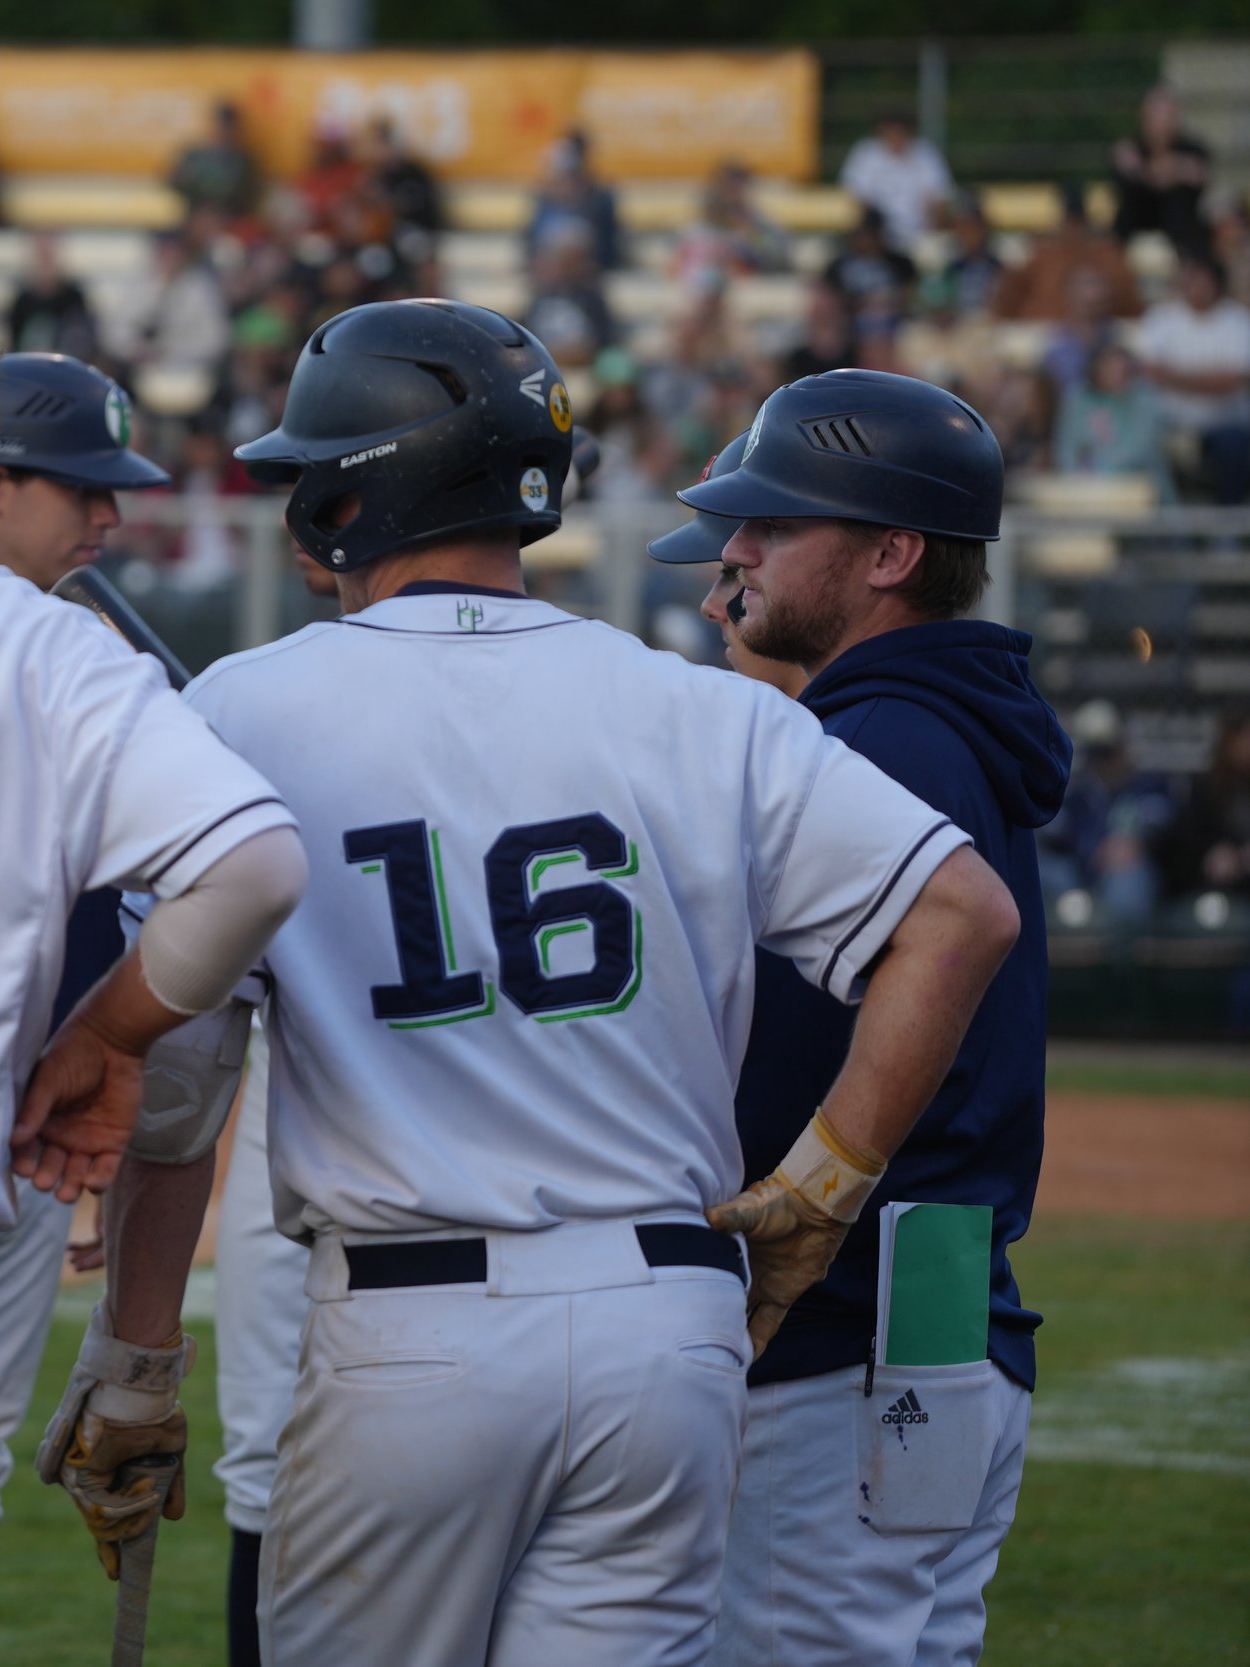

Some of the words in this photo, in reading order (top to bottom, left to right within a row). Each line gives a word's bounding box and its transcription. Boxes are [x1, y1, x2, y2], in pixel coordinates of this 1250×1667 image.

[340, 441, 398, 469] EASTON
[343, 811, 643, 1030] 16
[882, 1411, 929, 1424] adidas
